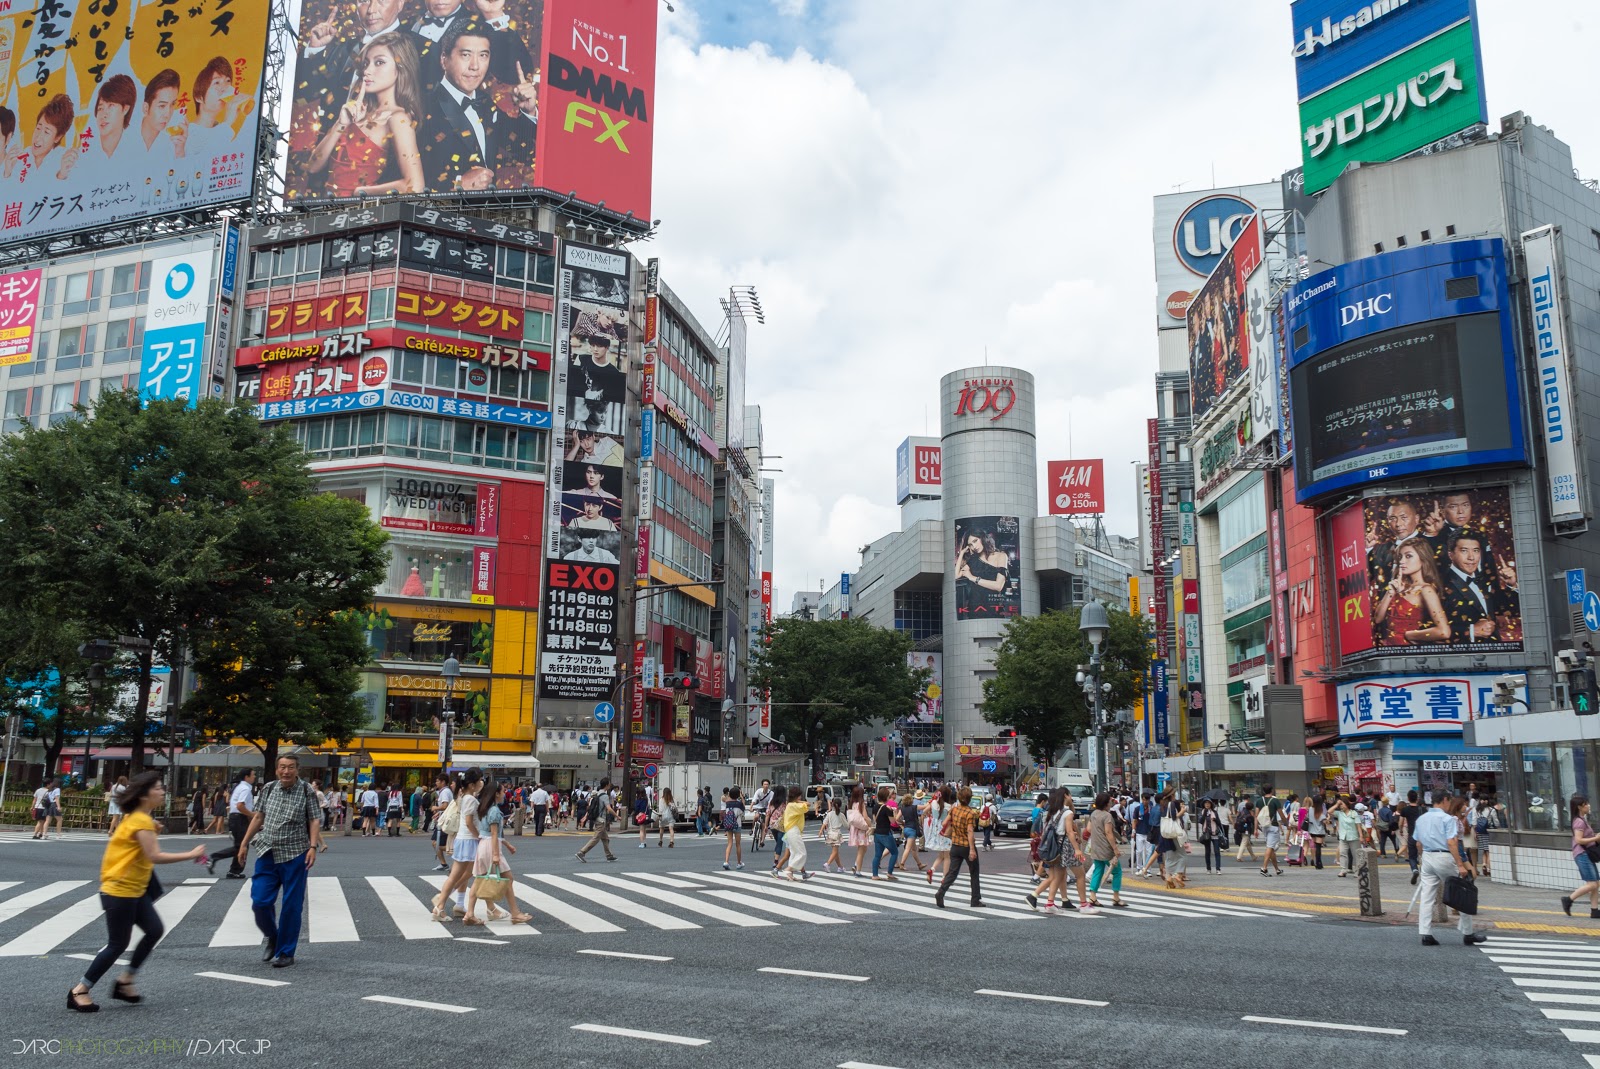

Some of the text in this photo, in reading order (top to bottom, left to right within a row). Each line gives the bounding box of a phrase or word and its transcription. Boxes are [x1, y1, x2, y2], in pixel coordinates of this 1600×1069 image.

[572, 26, 630, 74] No.1
[547, 52, 648, 123] DMM
[1303, 58, 1464, 158] サロンパス
[563, 101, 631, 155] FX
[26, 193, 85, 225] グラス
[0, 276, 39, 301] キン
[1287, 276, 1337, 311] DHC Channel
[153, 300, 201, 319] eyecity
[269, 295, 365, 330] プライス
[396, 291, 520, 331] コンタクト
[1340, 292, 1393, 327] DHC
[321, 333, 372, 358] ガスト
[481, 344, 538, 371] ガスト
[1531, 265, 1564, 444] Taisei neon
[238, 379, 260, 398] 7F
[292, 367, 354, 399] ガスト
[964, 378, 1014, 387] SHIBUYA
[267, 395, 356, 418] 英会話イーオン
[390, 392, 548, 425] AEON 英会話イーオン
[953, 386, 1016, 421] 109
[1325, 388, 1439, 422] COSMO PLANETARIUM SHIBUYA
[1325, 397, 1441, 433] コスモプラネタリウム渋谷
[919, 450, 940, 465] UN
[919, 466, 941, 482] QL
[1059, 465, 1093, 488] H&M
[1368, 466, 1389, 478] DHC
[1552, 474, 1573, 484] (03)
[395, 478, 466, 502] 1000%
[1072, 492, 1091, 500] この先
[1552, 482, 1575, 494] 3719
[1553, 492, 1577, 503] 2468
[1072, 500, 1098, 508] 150m
[477, 551, 490, 591] 毎日開催
[550, 563, 615, 591] EXO
[1184, 592, 1197, 601] JTB
[1337, 570, 1367, 600] DMM
[549, 590, 614, 607] 11月6日(金)
[1344, 595, 1364, 623] FX
[548, 604, 613, 620] 11月7日(土)
[548, 618, 612, 634] 11月8日(日)
[546, 634, 613, 652] 東京ドーム
[557, 655, 602, 665] チケットぴあ
[388, 674, 473, 692] L'OCCITNE
